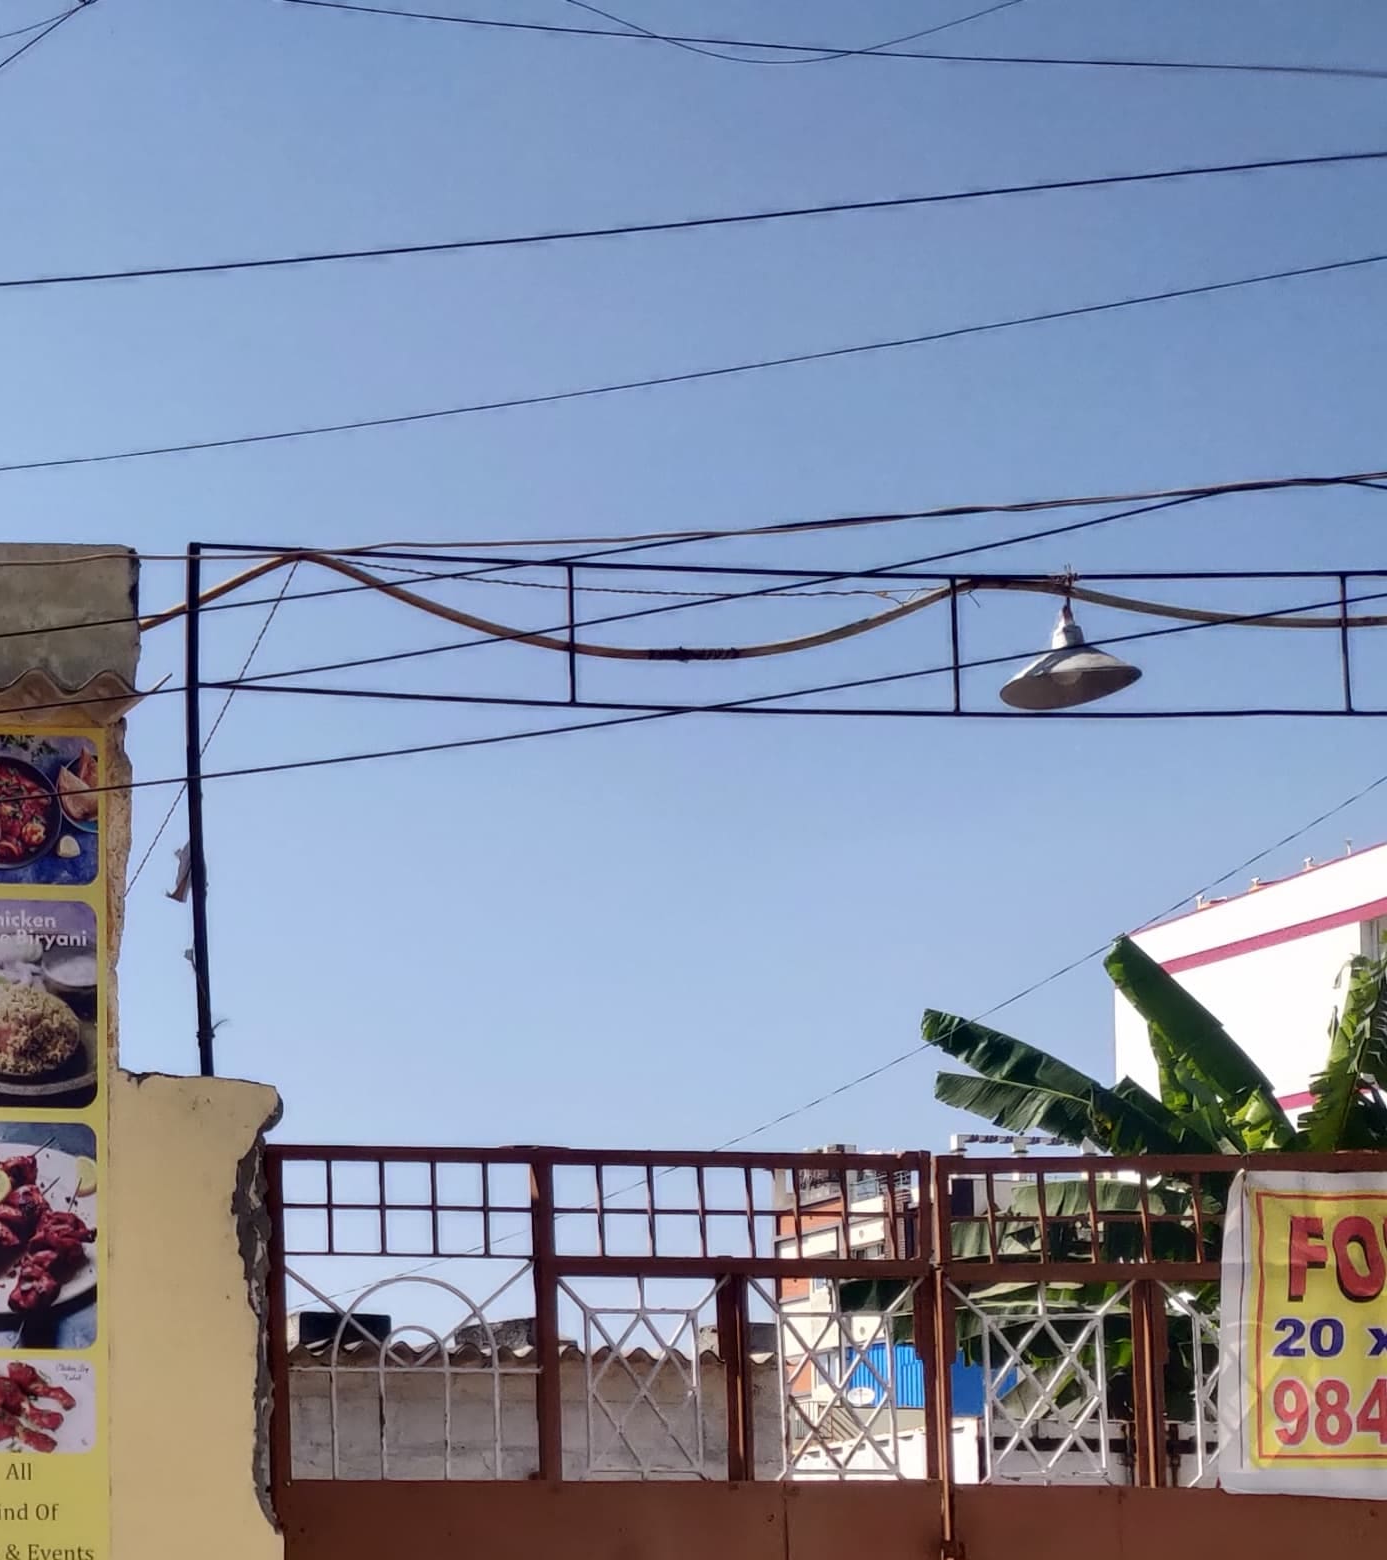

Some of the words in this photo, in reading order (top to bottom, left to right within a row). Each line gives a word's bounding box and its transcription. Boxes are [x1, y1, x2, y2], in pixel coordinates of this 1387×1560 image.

[16, 929, 88, 950] Biryani
[1288, 1214, 1387, 1304] FO
[1274, 1318, 1344, 1358] 20
[6, 1462, 32, 1480] All
[35, 1503, 59, 1521] Of
[5, 1544, 20, 1560] &
